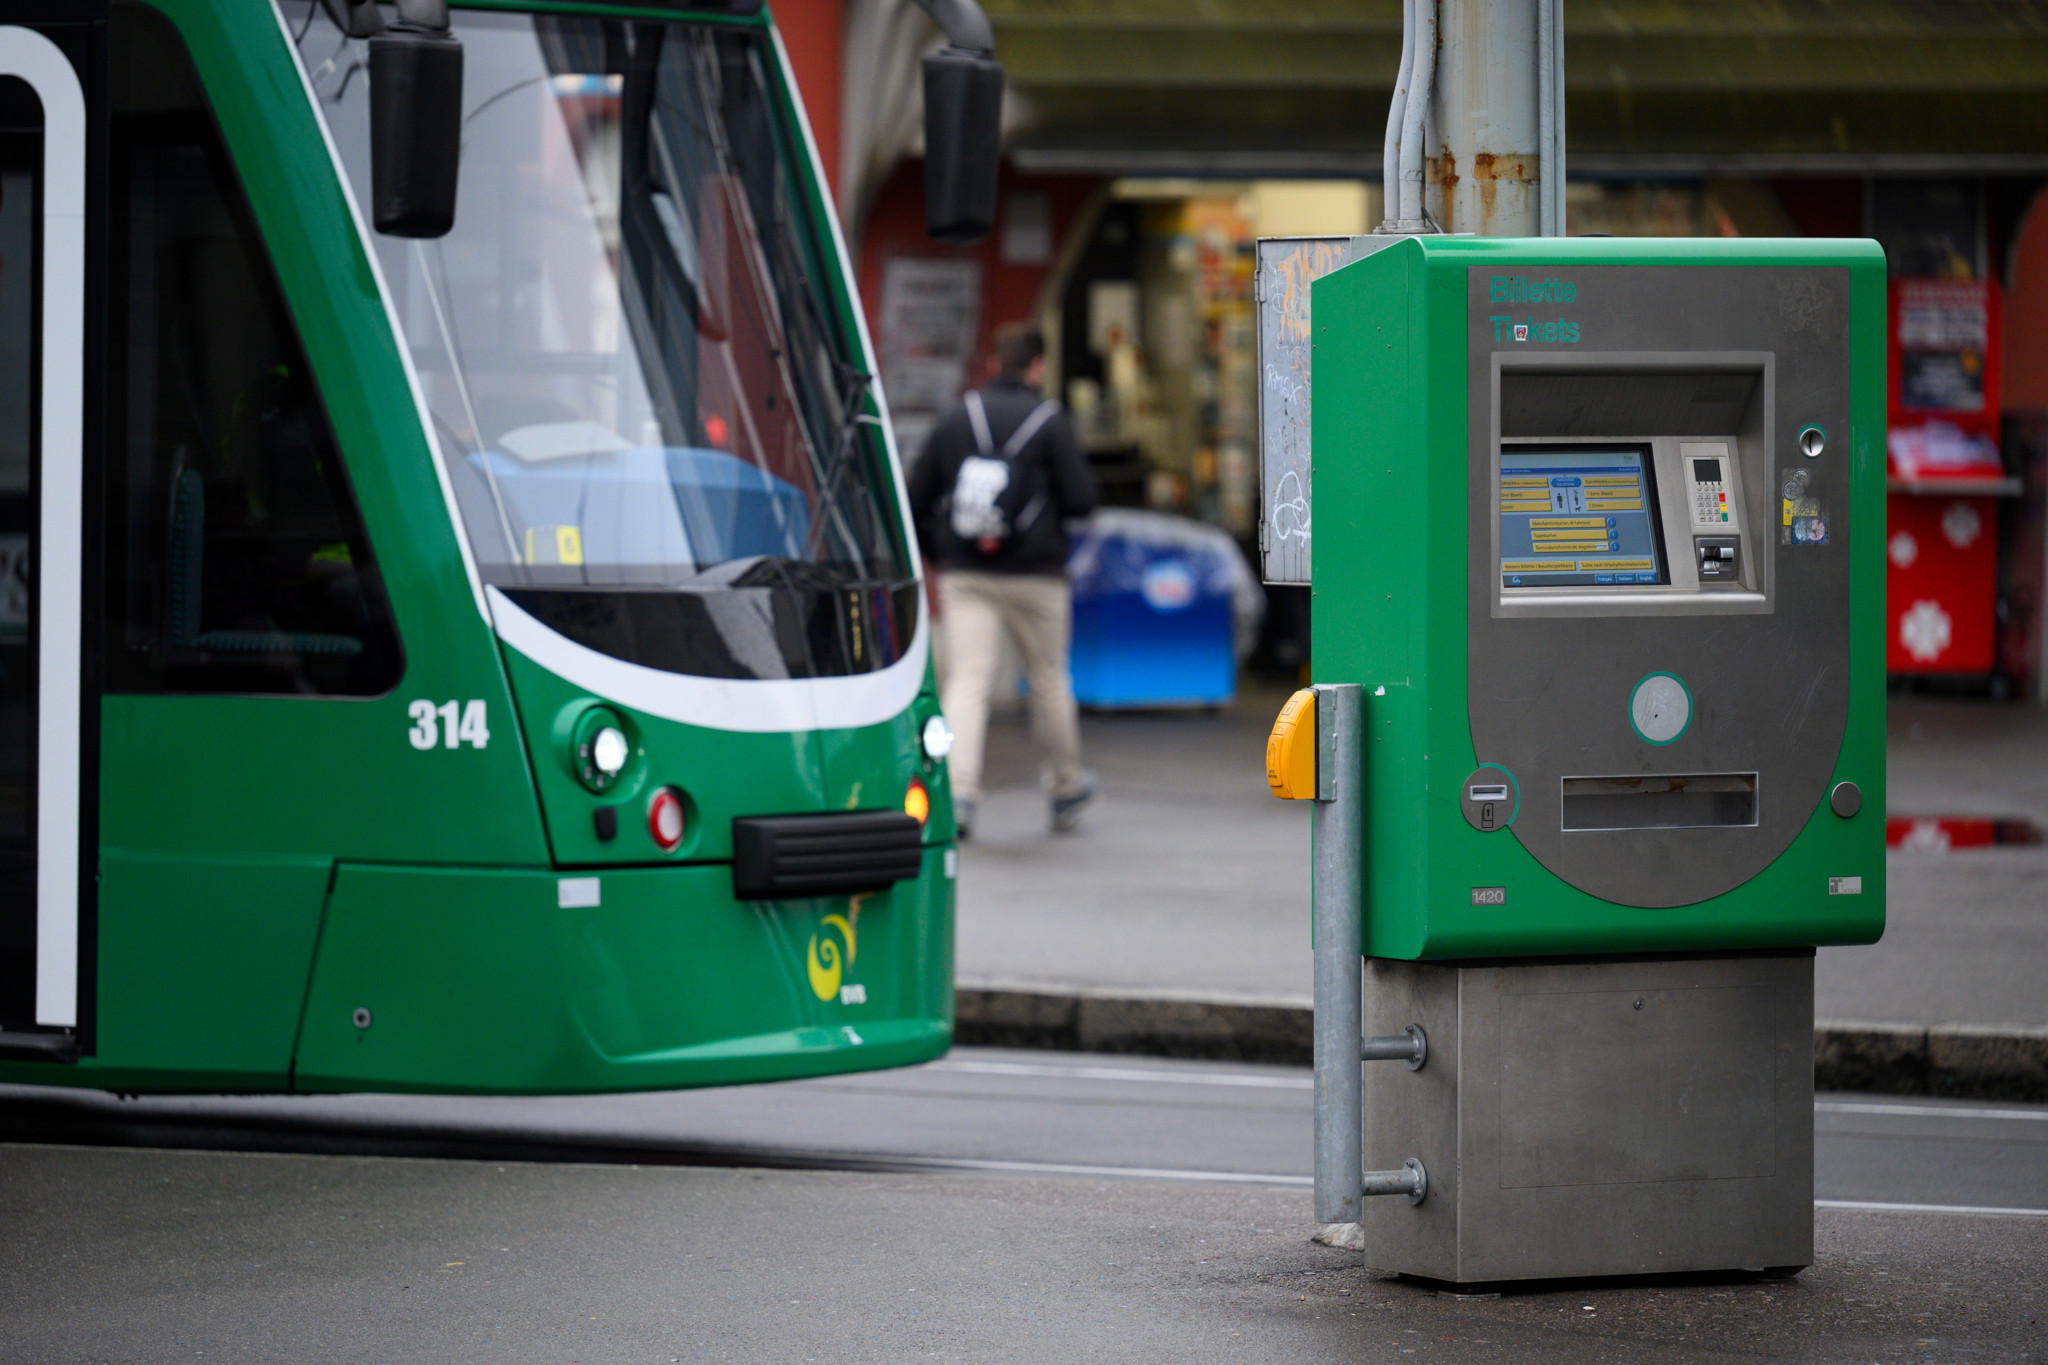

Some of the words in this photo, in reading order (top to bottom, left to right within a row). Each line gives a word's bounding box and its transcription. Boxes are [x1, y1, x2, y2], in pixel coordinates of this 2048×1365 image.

[1490, 275, 1577, 303] Billette
[408, 699, 490, 750] 314
[1472, 890, 1504, 903] 1420
